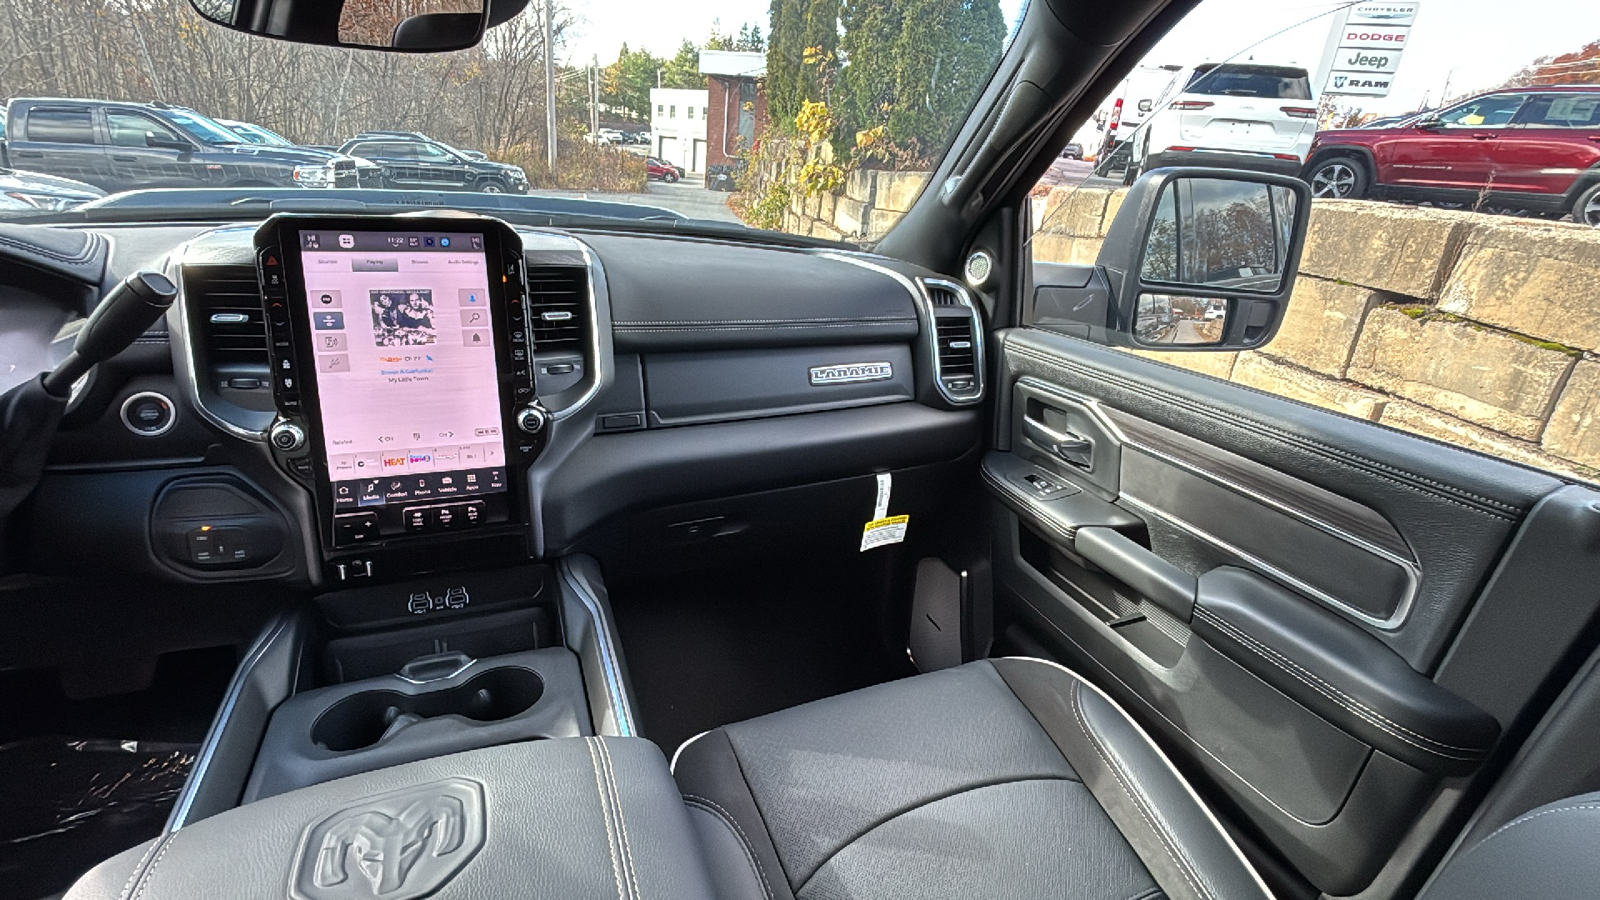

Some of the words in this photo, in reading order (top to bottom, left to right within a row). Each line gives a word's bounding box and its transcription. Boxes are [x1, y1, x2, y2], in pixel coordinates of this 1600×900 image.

[1346, 33, 1406, 42] DODGE
[1347, 52, 1389, 69] Jeep
[1348, 80, 1390, 89] RAM
[383, 457, 405, 467] HEAT
